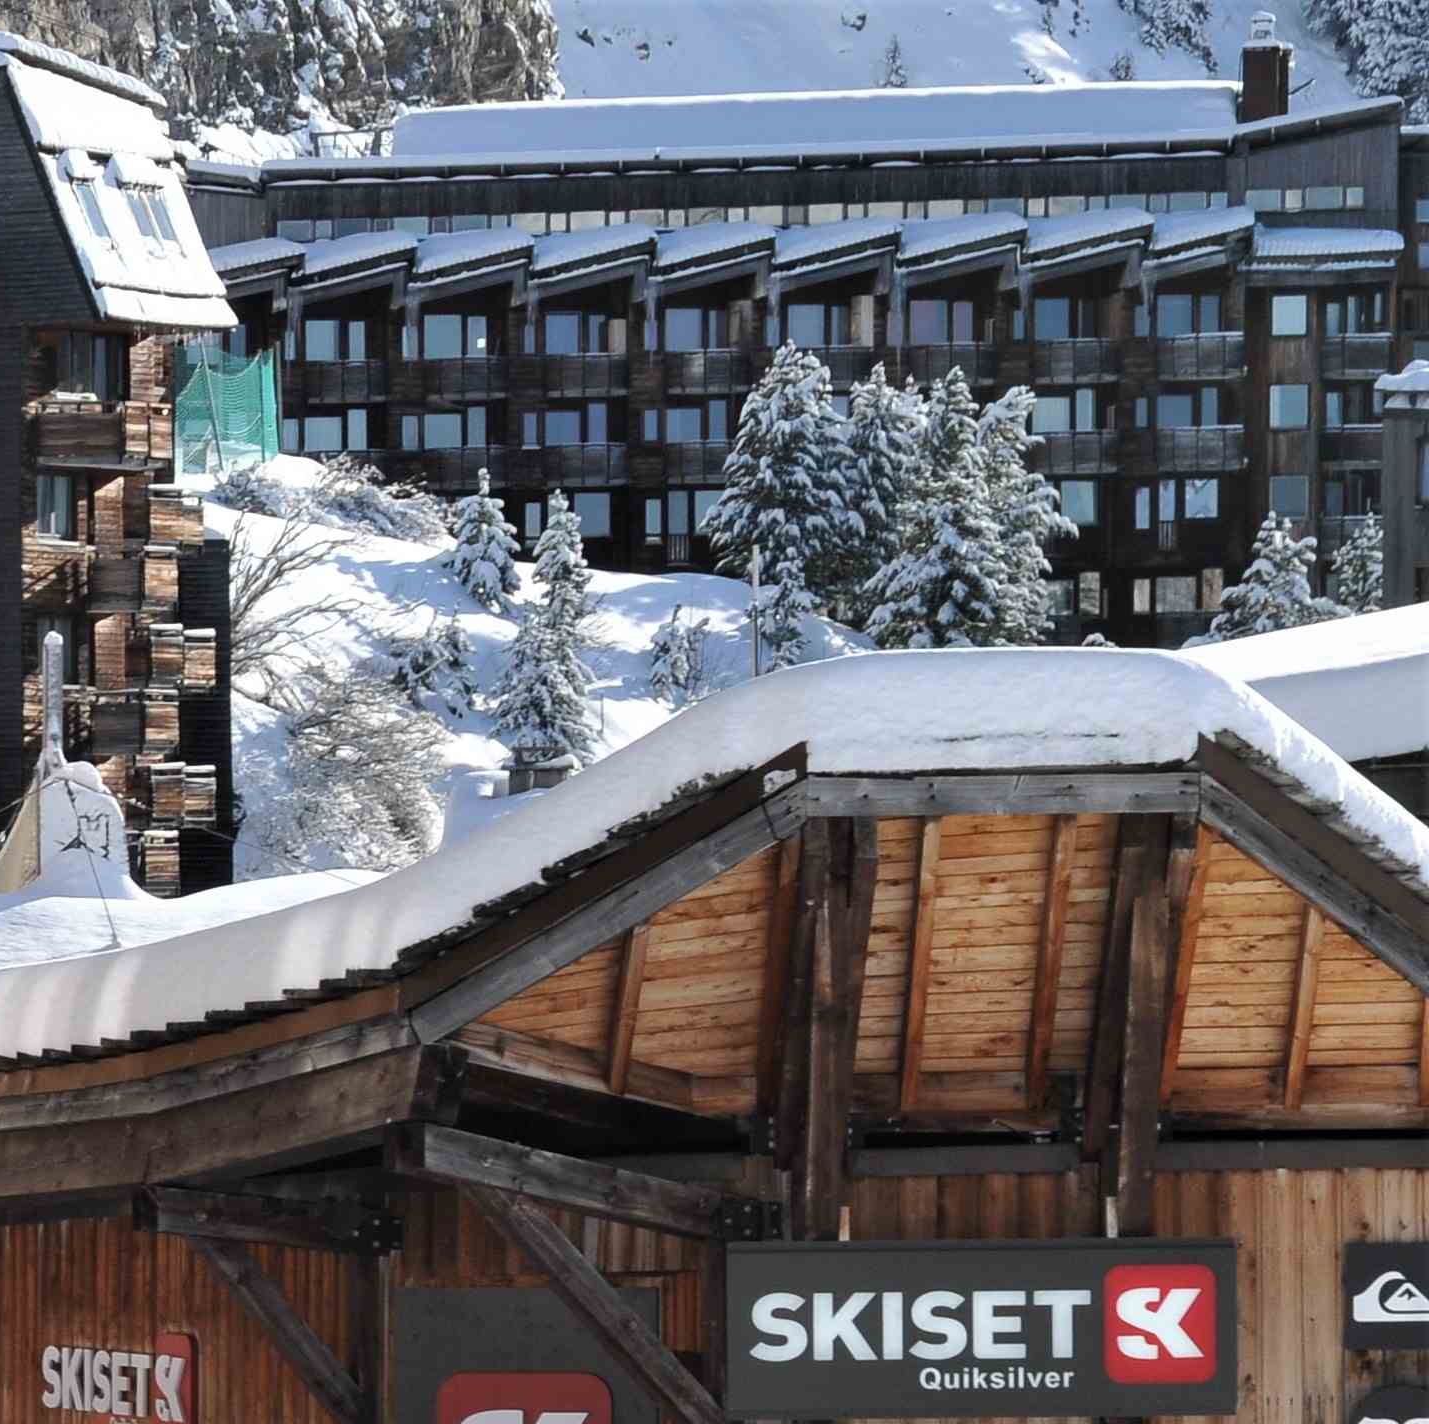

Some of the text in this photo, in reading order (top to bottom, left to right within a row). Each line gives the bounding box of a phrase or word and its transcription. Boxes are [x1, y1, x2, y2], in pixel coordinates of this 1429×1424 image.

[749, 1289, 1092, 1363] SKISET
[42, 1344, 152, 1418] SKISET
[918, 1367, 1075, 1391] Quiksilver
